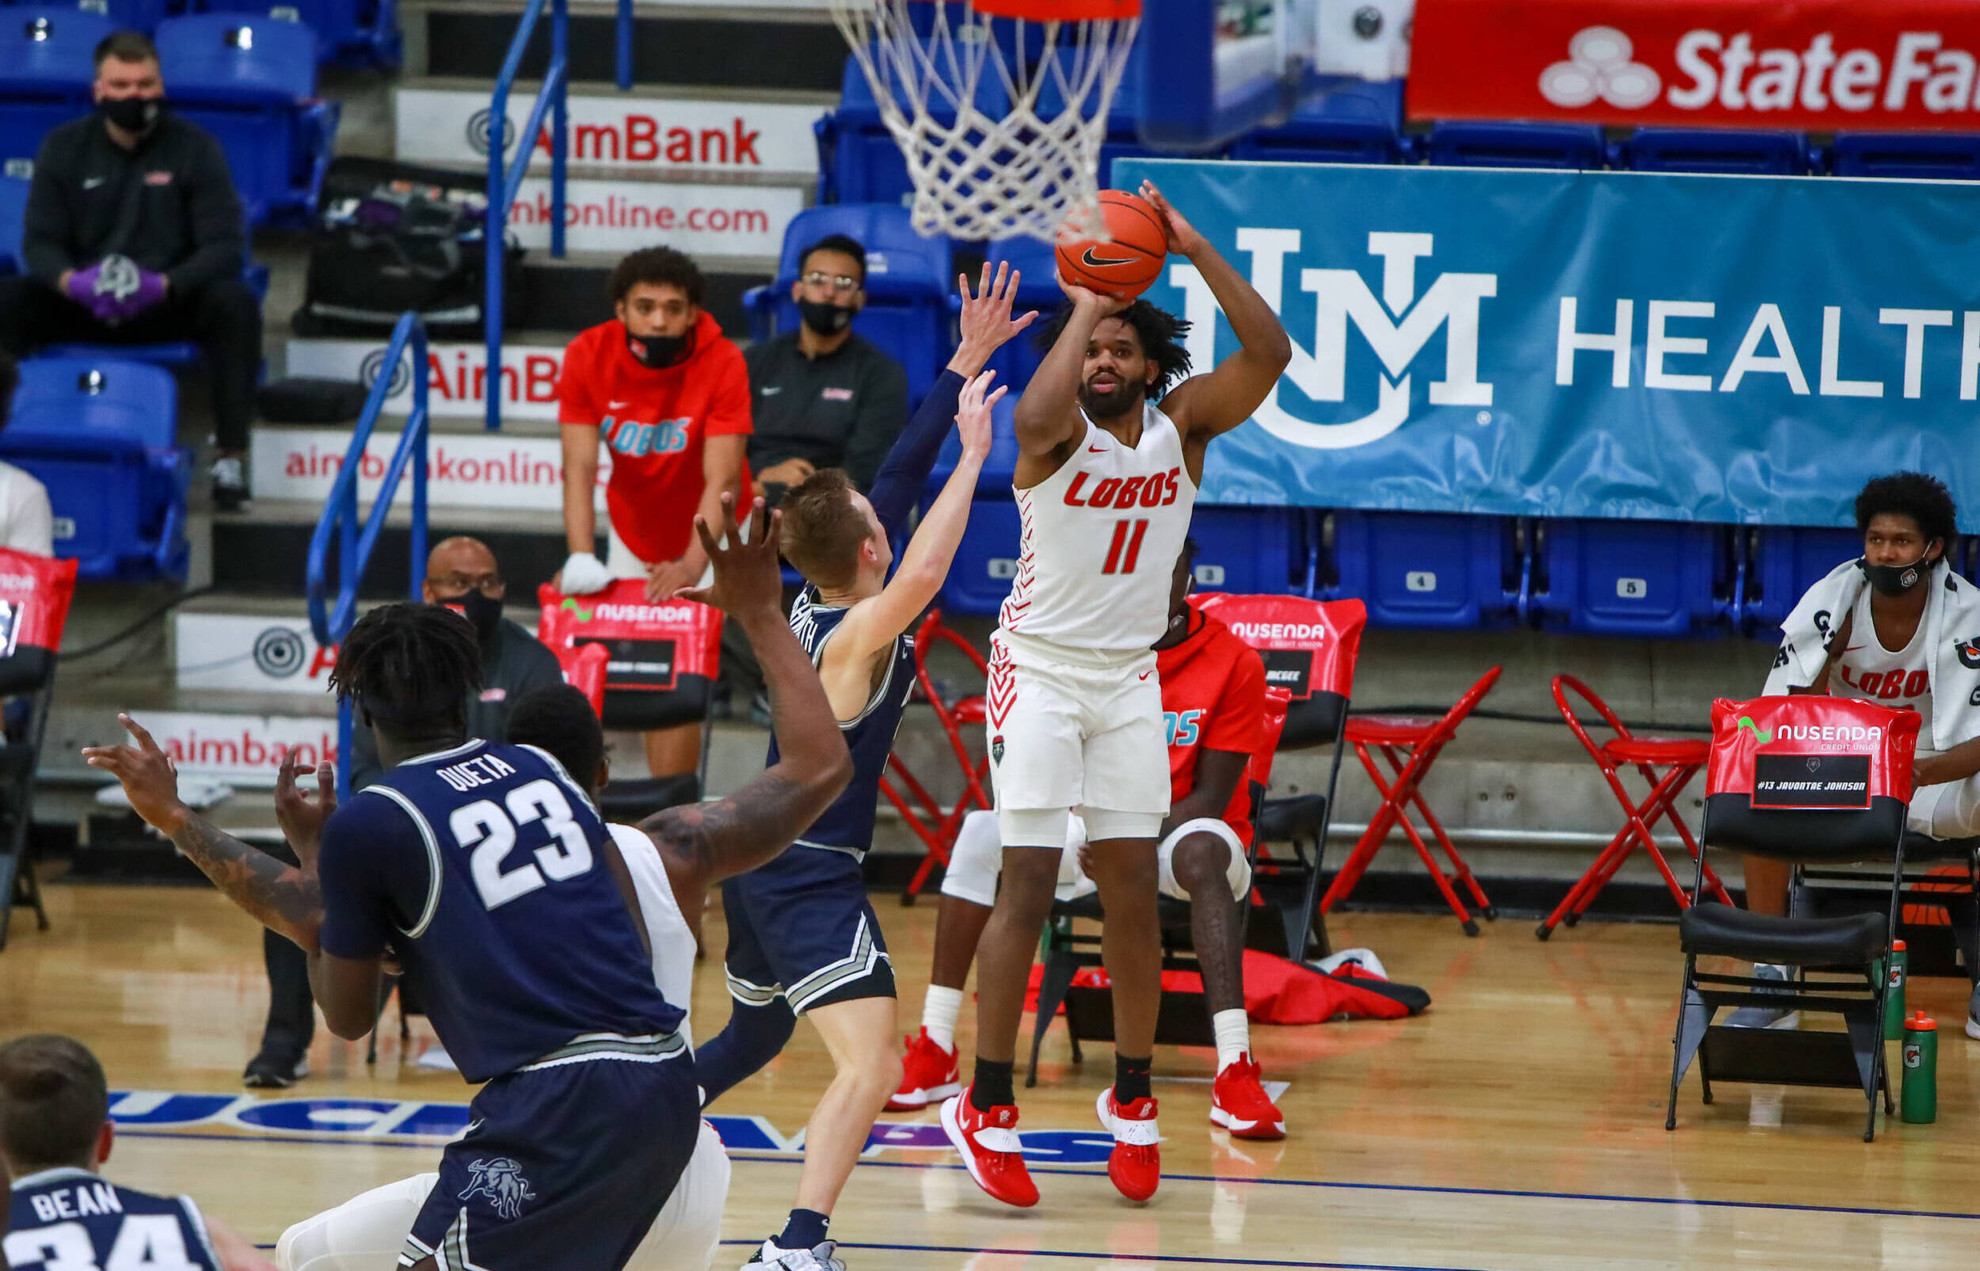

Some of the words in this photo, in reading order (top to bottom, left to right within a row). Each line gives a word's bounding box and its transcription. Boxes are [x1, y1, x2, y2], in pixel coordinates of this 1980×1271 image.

[1667, 29, 1882, 111] State
[1884, 32, 1980, 113] Fa
[535, 115, 760, 164] mBank
[510, 193, 768, 233] nkonline.com
[427, 352, 560, 402] AimB
[1063, 467, 1180, 509] LOBOS
[1101, 518, 1149, 575] 11
[1626, 582, 1637, 595] 5
[1231, 622, 1325, 640] NUSENDA
[1841, 664, 1932, 699] LOBO
[1777, 724, 1882, 740] NUSENDA
[1821, 743, 1851, 751] CREDIT
[1854, 743, 1881, 752] UNION
[436, 753, 517, 792] QUETA
[1757, 781, 1775, 790] #13
[1776, 781, 1823, 791] JAVONTAE
[1824, 782, 1866, 791] JOHNSON
[450, 778, 593, 911] 23
[30, 1183, 124, 1222] BEAN
[2, 1214, 203, 1271] 34
